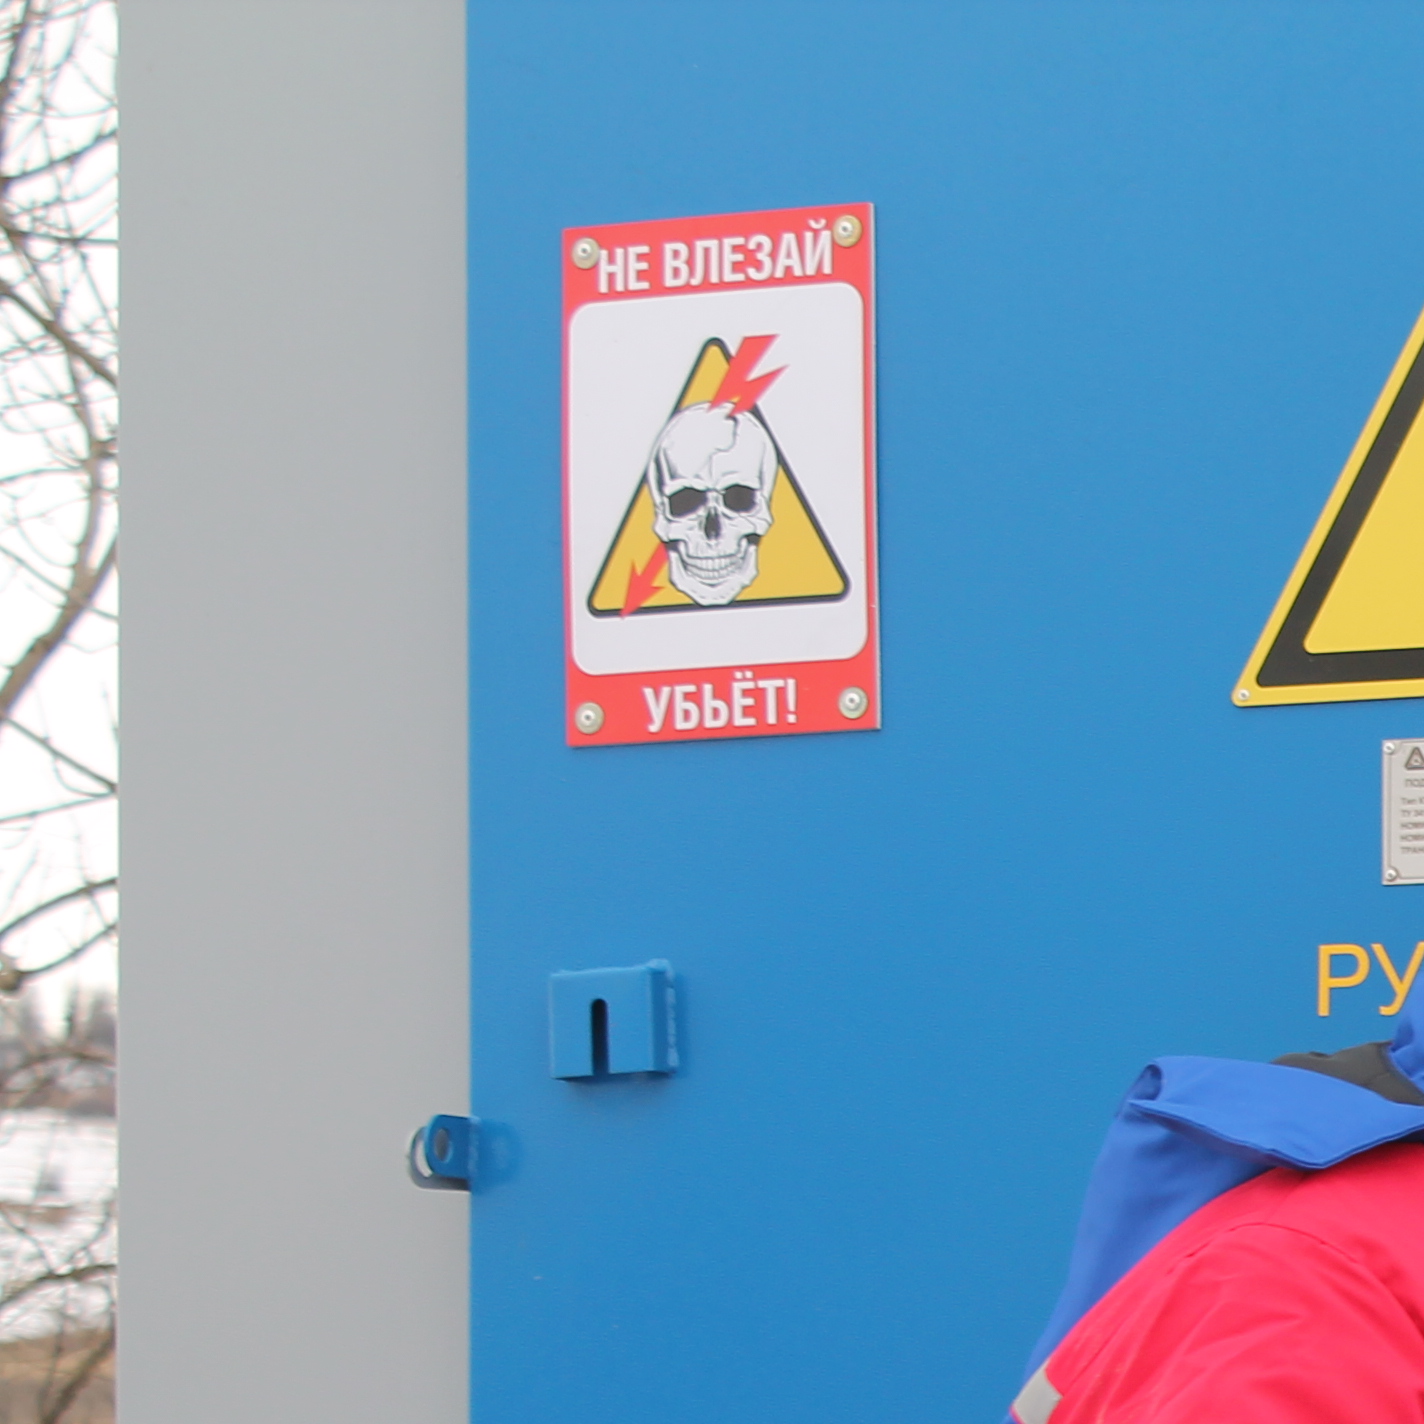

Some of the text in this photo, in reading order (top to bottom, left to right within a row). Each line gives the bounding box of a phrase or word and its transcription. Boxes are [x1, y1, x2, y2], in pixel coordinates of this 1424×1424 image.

[597, 218, 833, 294] НЕ ВЛЕЗАЙ
[643, 671, 798, 733] УБЬЁТ!
